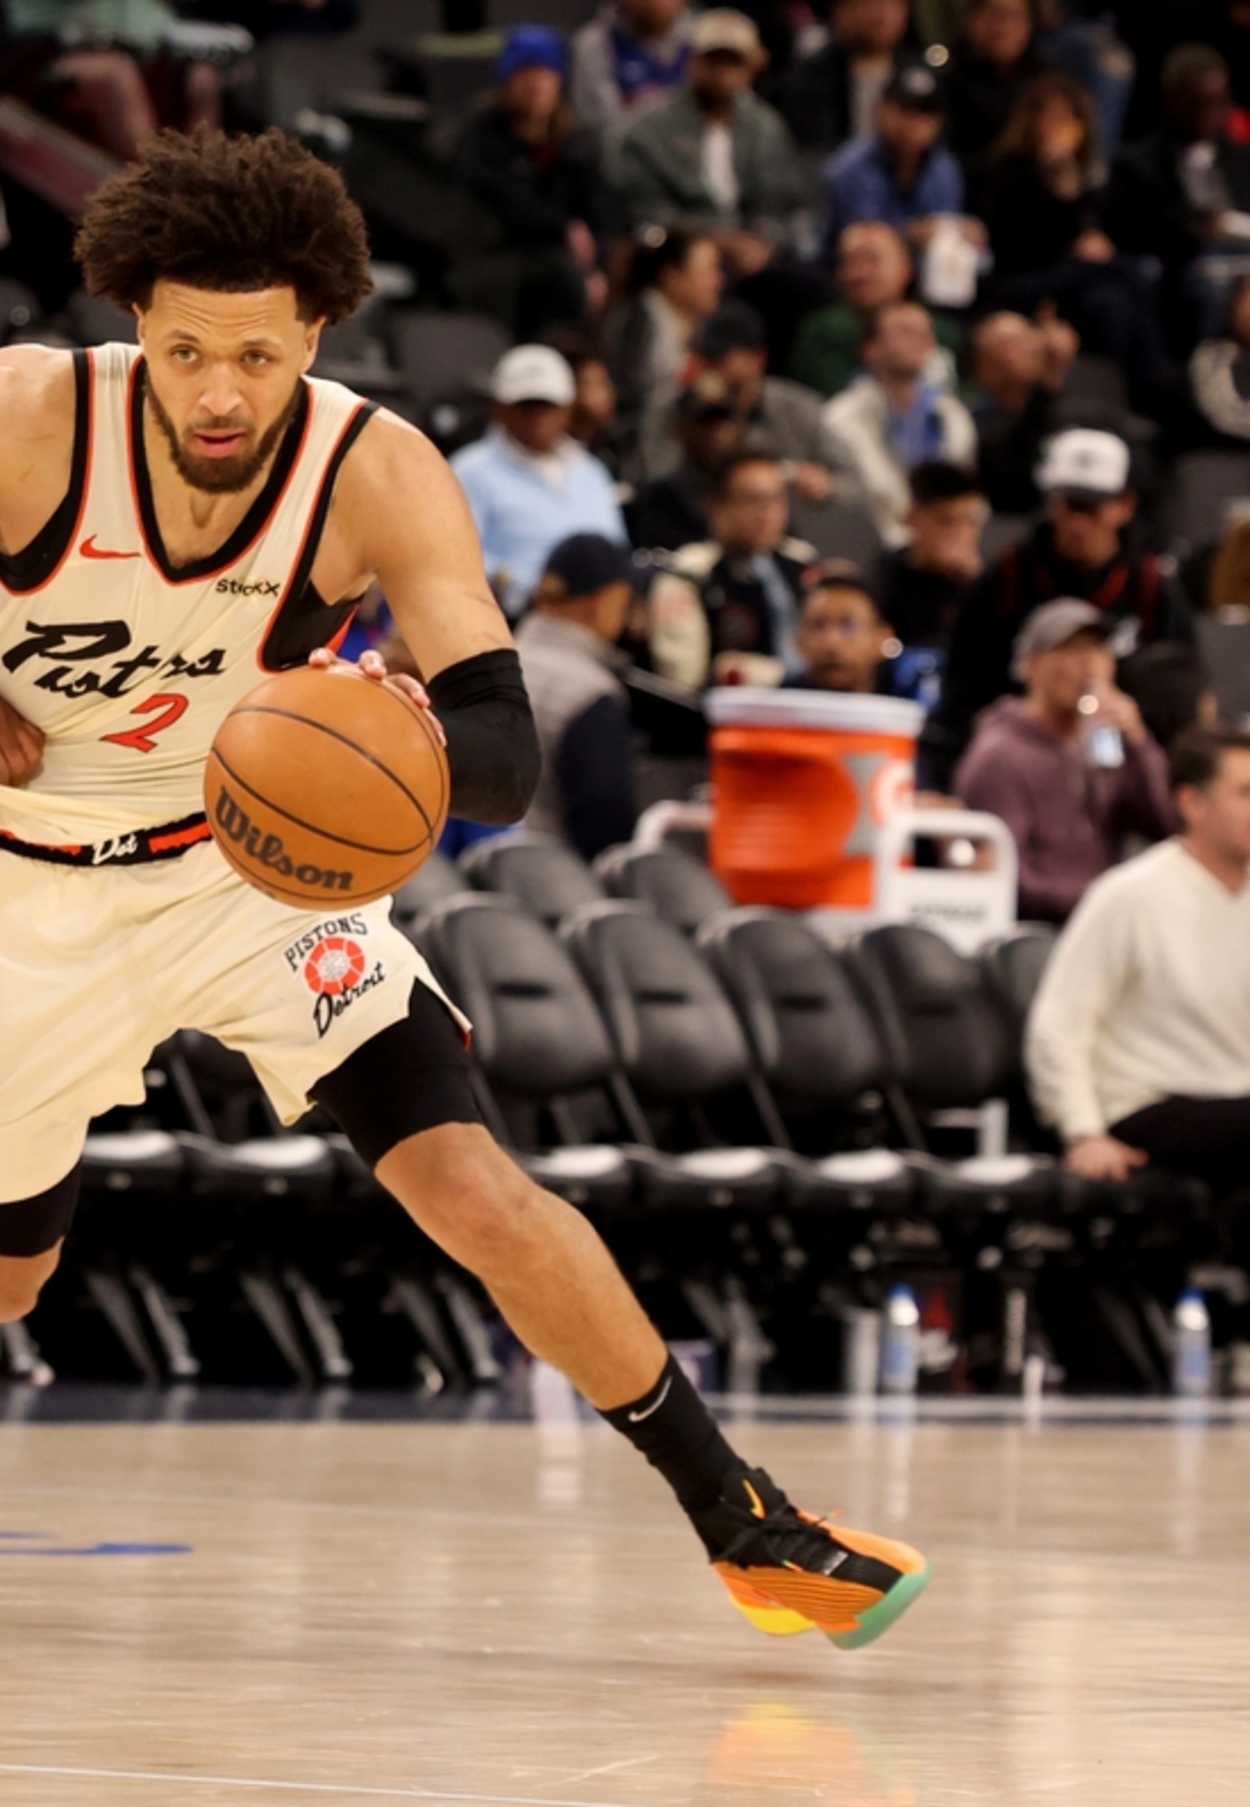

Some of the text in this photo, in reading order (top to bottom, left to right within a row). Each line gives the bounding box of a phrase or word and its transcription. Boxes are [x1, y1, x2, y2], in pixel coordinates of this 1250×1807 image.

[2, 620, 227, 699] Pistns
[99, 692, 189, 753] 2
[216, 785, 353, 891] Wilson
[284, 912, 369, 974] PISTONS
[313, 961, 387, 1040] Detroit
